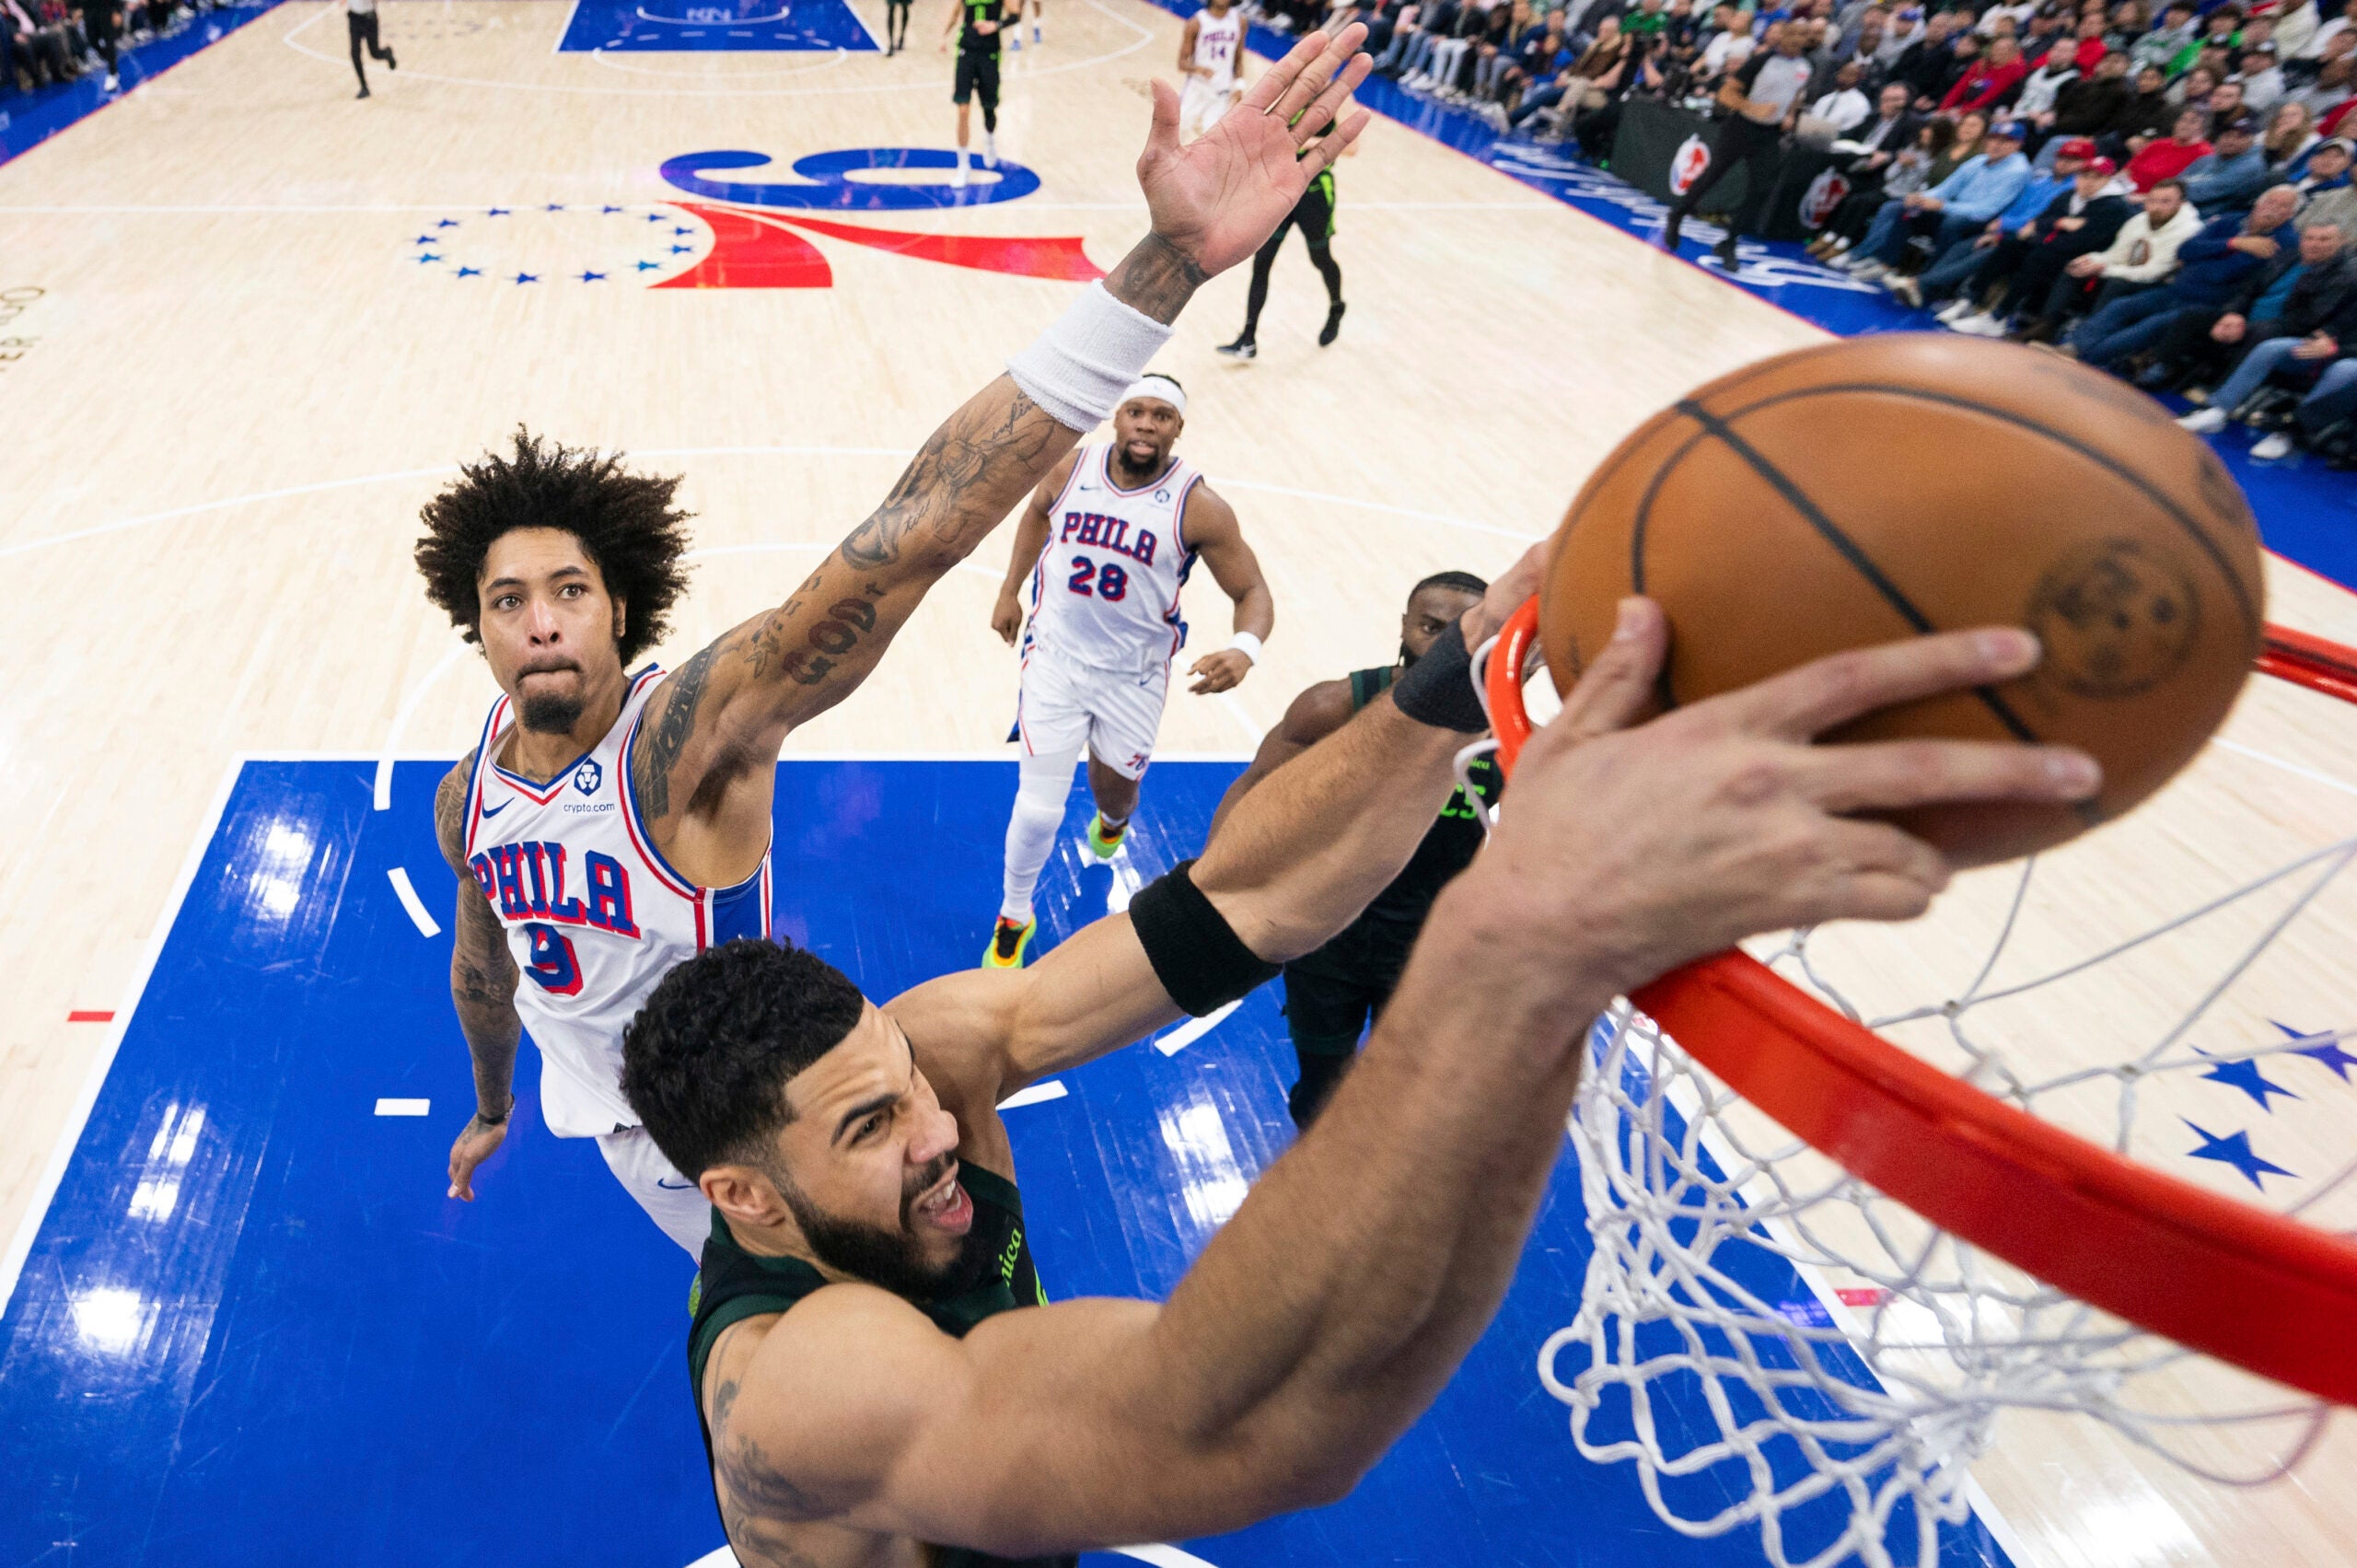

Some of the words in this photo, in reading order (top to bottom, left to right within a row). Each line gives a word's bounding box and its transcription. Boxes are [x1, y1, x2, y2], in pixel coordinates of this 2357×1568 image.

[1061, 512, 1157, 567] PHILA
[1068, 556, 1129, 601] 28
[563, 803, 615, 814] crypto.com
[470, 841, 642, 940] PHILA
[524, 923, 584, 996] 9
